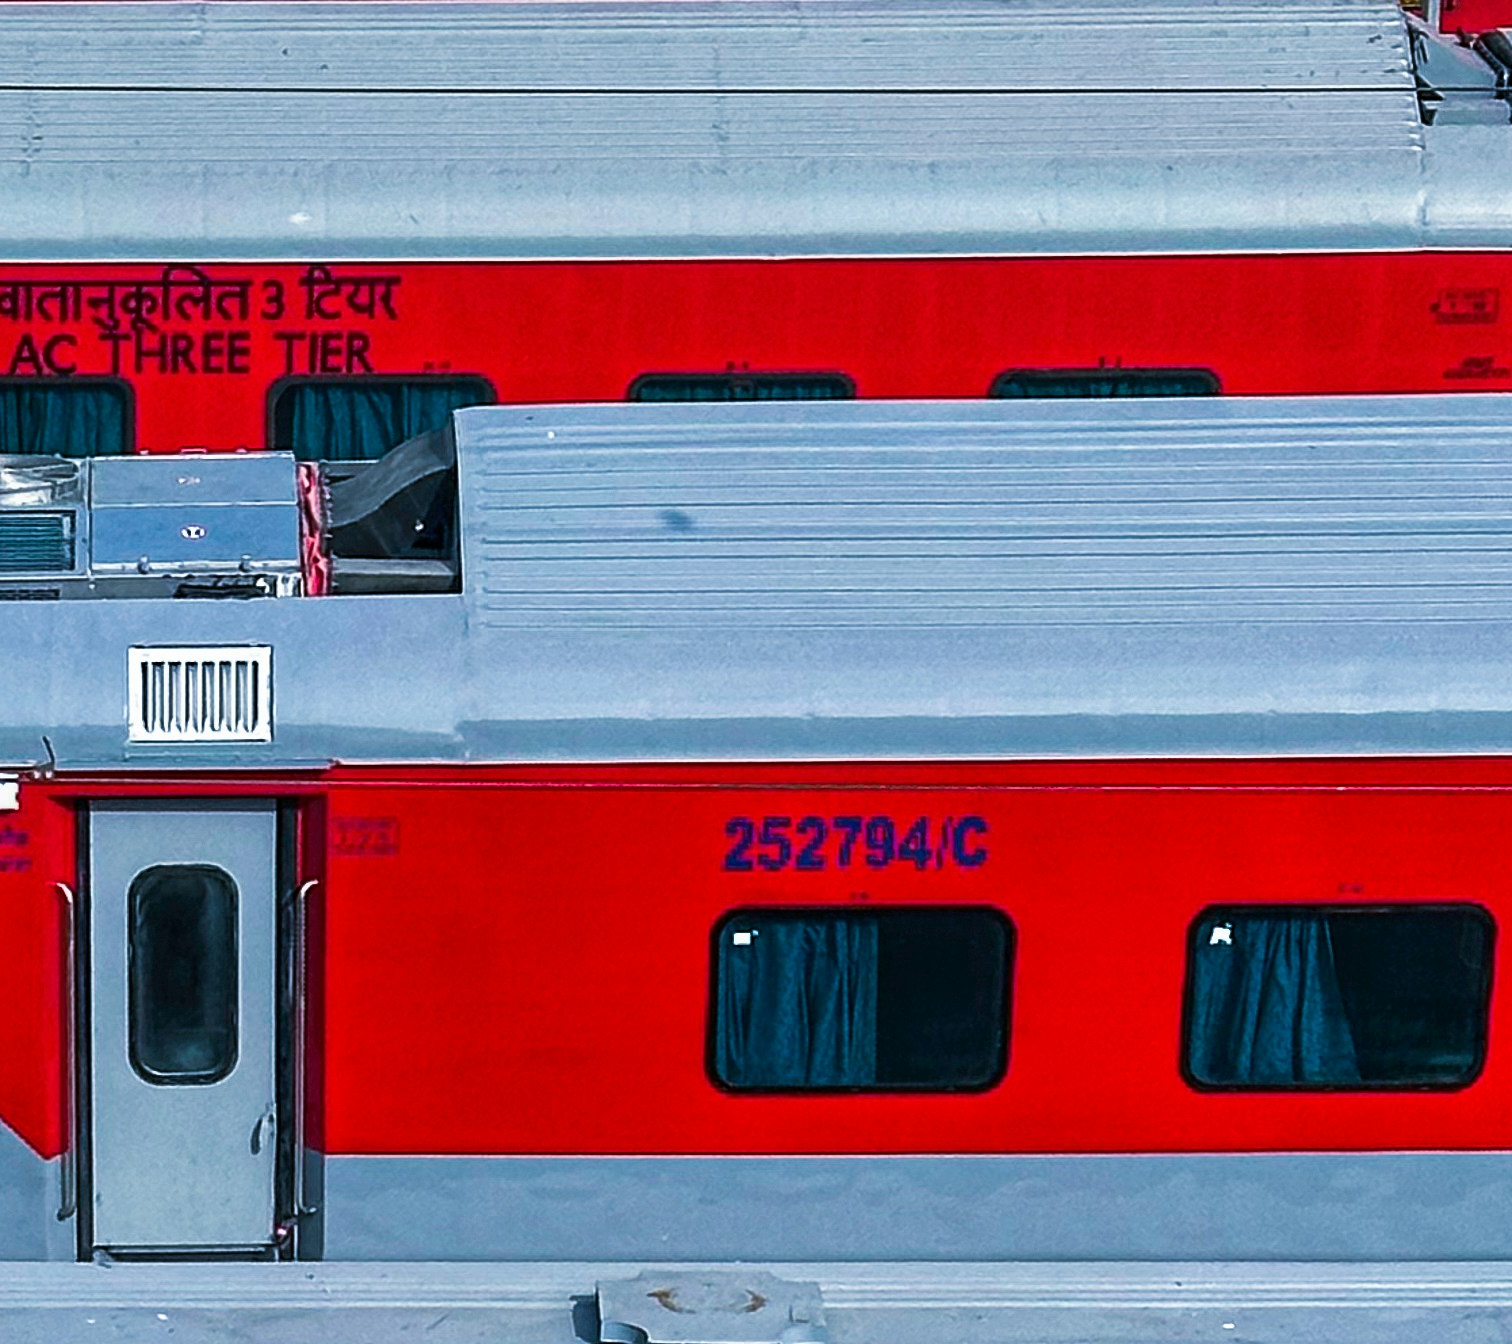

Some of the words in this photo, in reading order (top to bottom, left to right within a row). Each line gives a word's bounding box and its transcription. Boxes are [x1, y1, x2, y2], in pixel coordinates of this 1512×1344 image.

[261, 280, 285, 320] 3
[299, 264, 402, 320] टियर
[8, 333, 78, 375] AC
[97, 330, 251, 374] THREE
[273, 330, 375, 374] TIER
[721, 815, 988, 870] 252794/C
